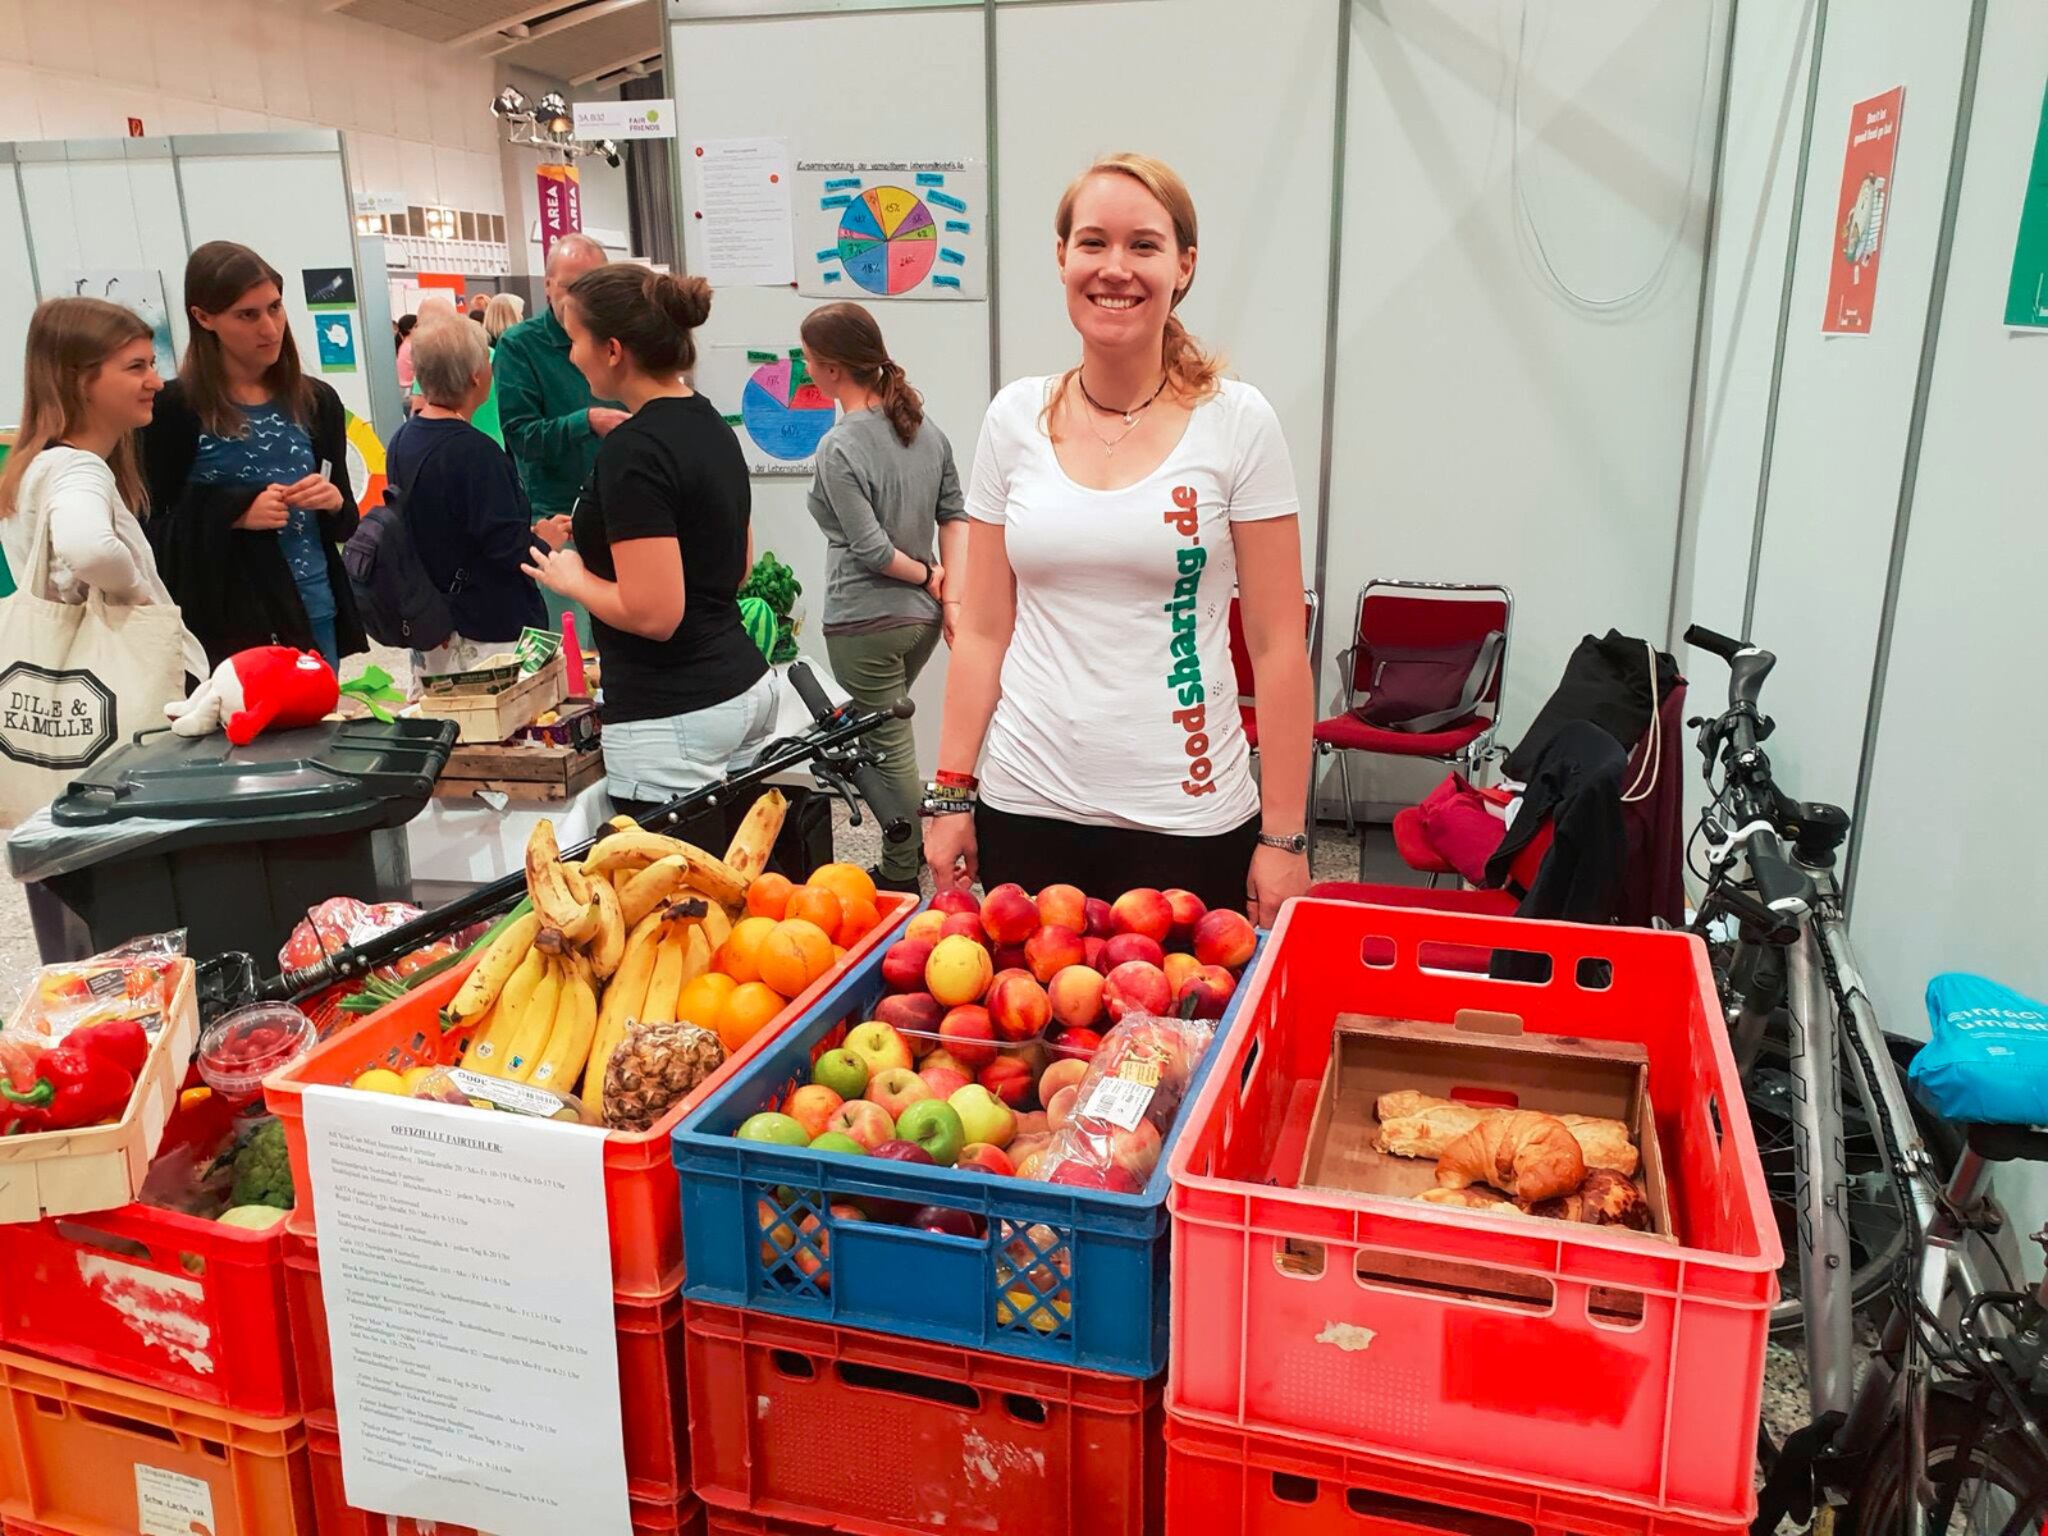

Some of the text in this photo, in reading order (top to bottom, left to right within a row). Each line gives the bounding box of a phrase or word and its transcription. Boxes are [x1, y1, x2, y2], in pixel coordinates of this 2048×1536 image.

[630, 124, 660, 132] FRIENDS
[546, 185, 562, 230] AREA
[569, 187, 580, 231] AREA
[862, 262, 880, 274] 18%
[1164, 485, 1217, 798] foodsharing.de
[71, 698, 88, 716] &
[4, 711, 94, 738] KAMILLE
[390, 1123, 443, 1142] OFFIZIELLE
[445, 1134, 503, 1154] FAIRTEILER:
